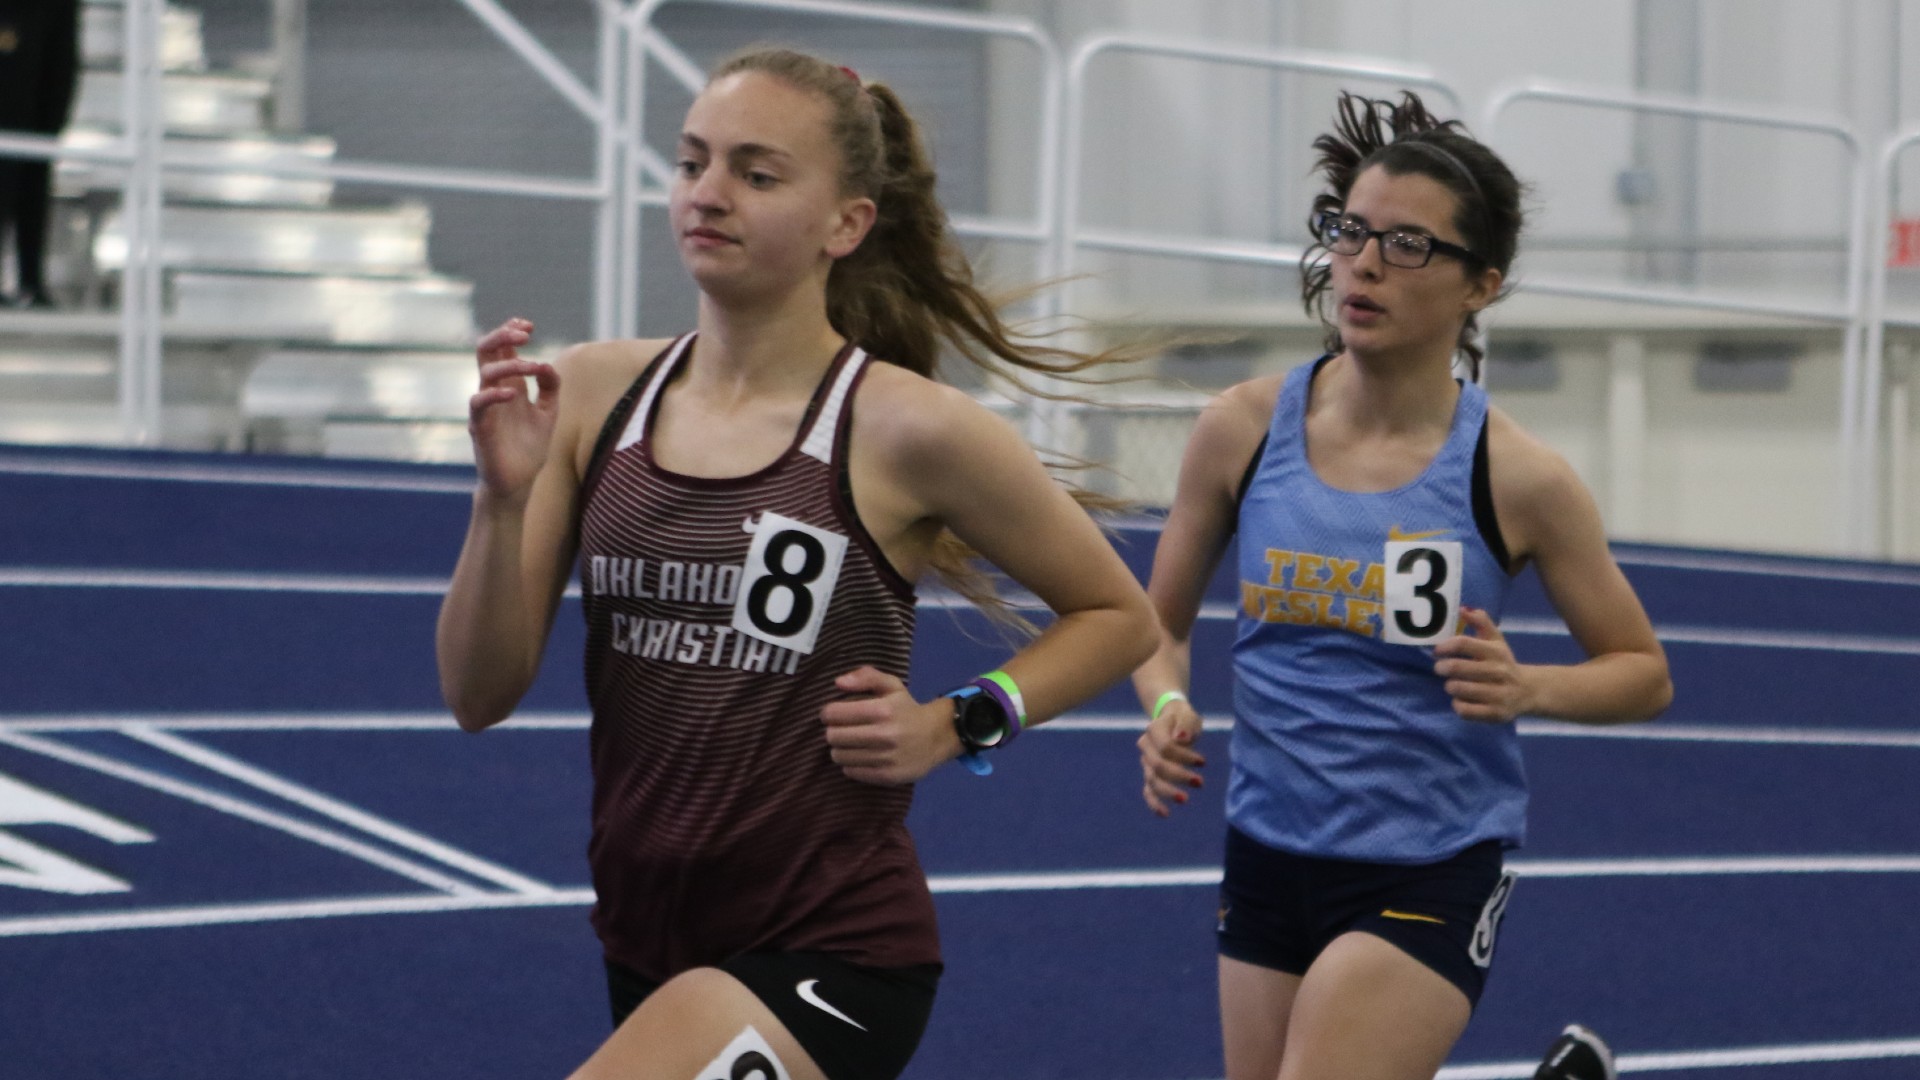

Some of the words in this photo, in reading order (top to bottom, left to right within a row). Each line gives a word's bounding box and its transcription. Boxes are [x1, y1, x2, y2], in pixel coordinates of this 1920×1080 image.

[591, 555, 742, 605] OKLAHO
[746, 529, 826, 638] 8
[1241, 580, 1386, 638] WESLE
[1264, 548, 1386, 599] TEXA
[1393, 547, 1448, 639] 3
[1476, 874, 1512, 960] 3
